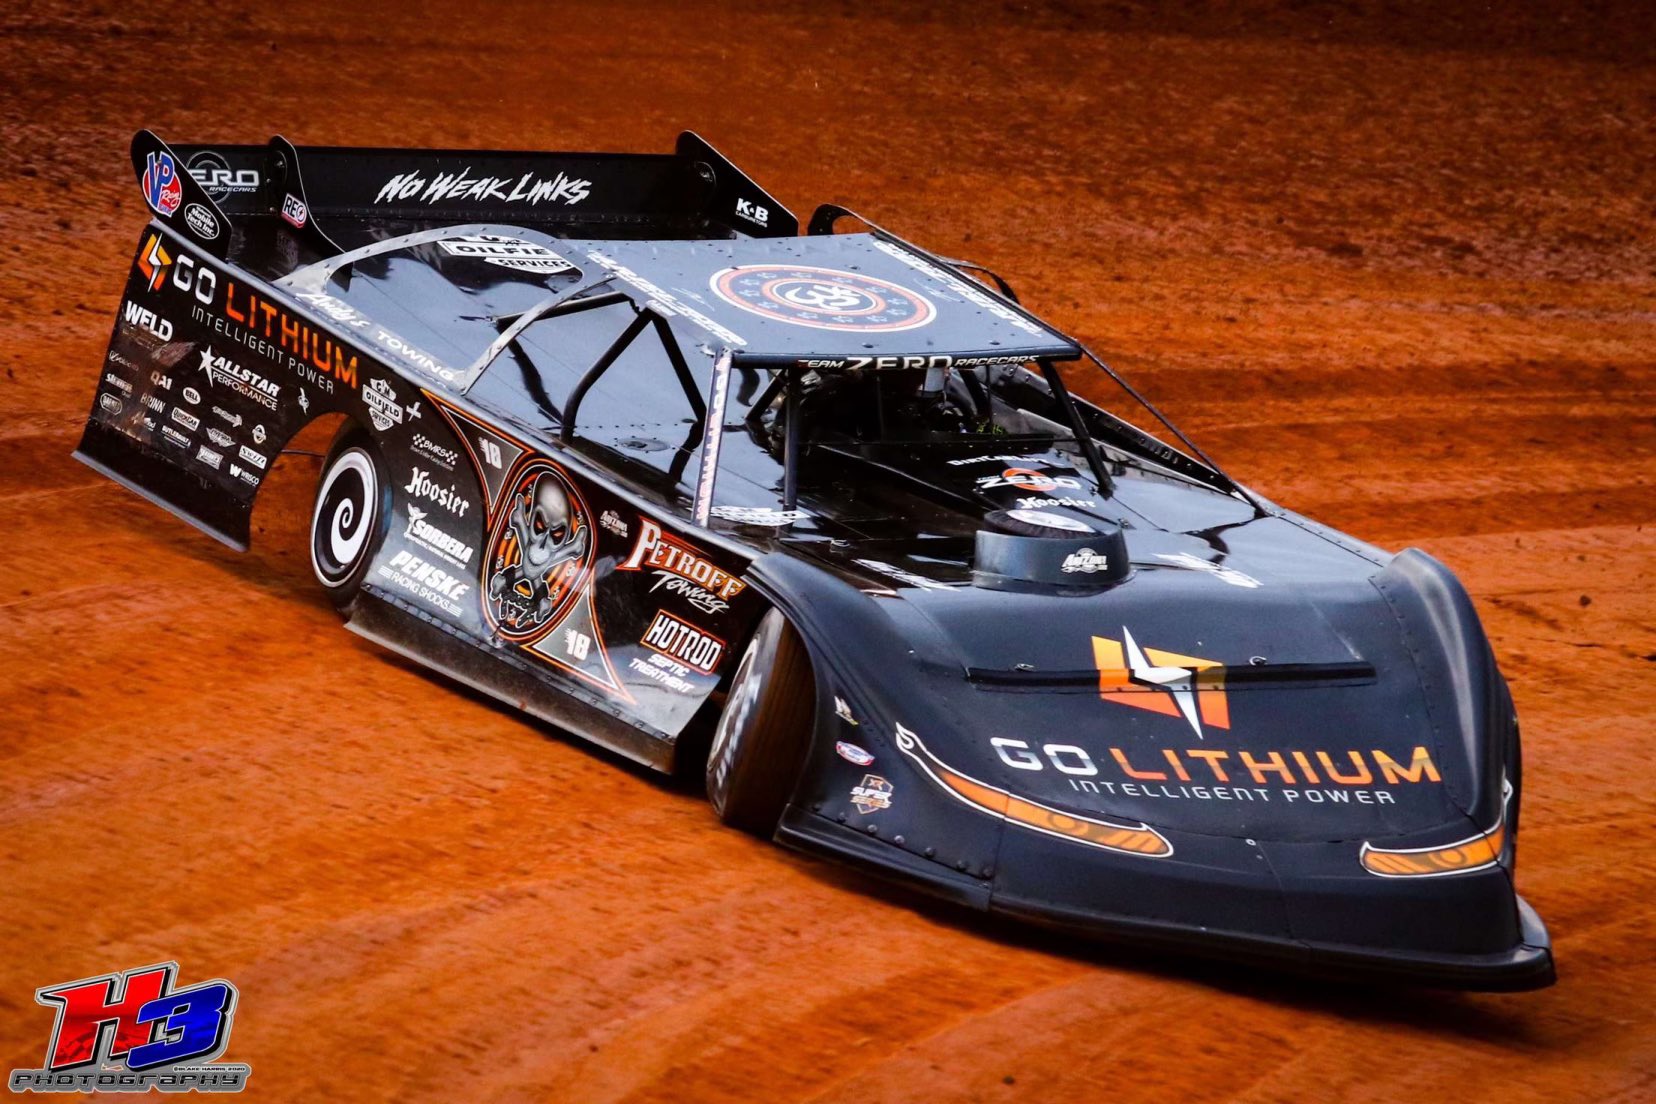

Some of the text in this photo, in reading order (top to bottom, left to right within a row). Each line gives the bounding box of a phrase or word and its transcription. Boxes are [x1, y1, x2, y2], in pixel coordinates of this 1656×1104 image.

[146, 151, 176, 211] VP
[188, 169, 260, 187] ERO
[209, 186, 258, 194] RACECARS
[187, 215, 203, 230] Tech
[203, 221, 215, 236] Inc.
[190, 207, 215, 227] Mobile
[456, 245, 551, 256] OILFIE
[498, 259, 572, 268] SERVICES
[125, 300, 173, 342] WELD
[172, 254, 358, 389] GO LITHIUM
[192, 305, 284, 364] INTELLIGENT
[288, 357, 334, 394] POWER
[376, 330, 456, 382] TOWING
[847, 355, 952, 370] ZERO
[954, 355, 1040, 367] RACECARS
[212, 356, 281, 398] ALLSTAR
[212, 371, 278, 411] PERFORMANCE
[140, 393, 166, 414] BRINN
[185, 389, 199, 401] BELL
[365, 391, 400, 418] OILFIELD
[423, 440, 447, 457] BMRS
[478, 437, 502, 469] 18
[404, 466, 470, 518] Hoosier
[975, 475, 1081, 490] ZERO
[1016, 497, 1096, 509] Hoosier
[412, 519, 474, 563] SORBERA
[621, 517, 743, 597] PETROFF
[389, 550, 470, 601] PENSKE
[390, 571, 449, 609] RACING SHOCKS
[649, 570, 730, 613] Towing
[564, 628, 592, 661] 18
[645, 614, 722, 671] HOTROD
[628, 658, 696, 693] TREATMENT
[647, 653, 690, 677] SEPTIC
[989, 736, 1443, 785] GO LITHIUM
[1068, 778, 1396, 805] INTELLIGENT POWER
